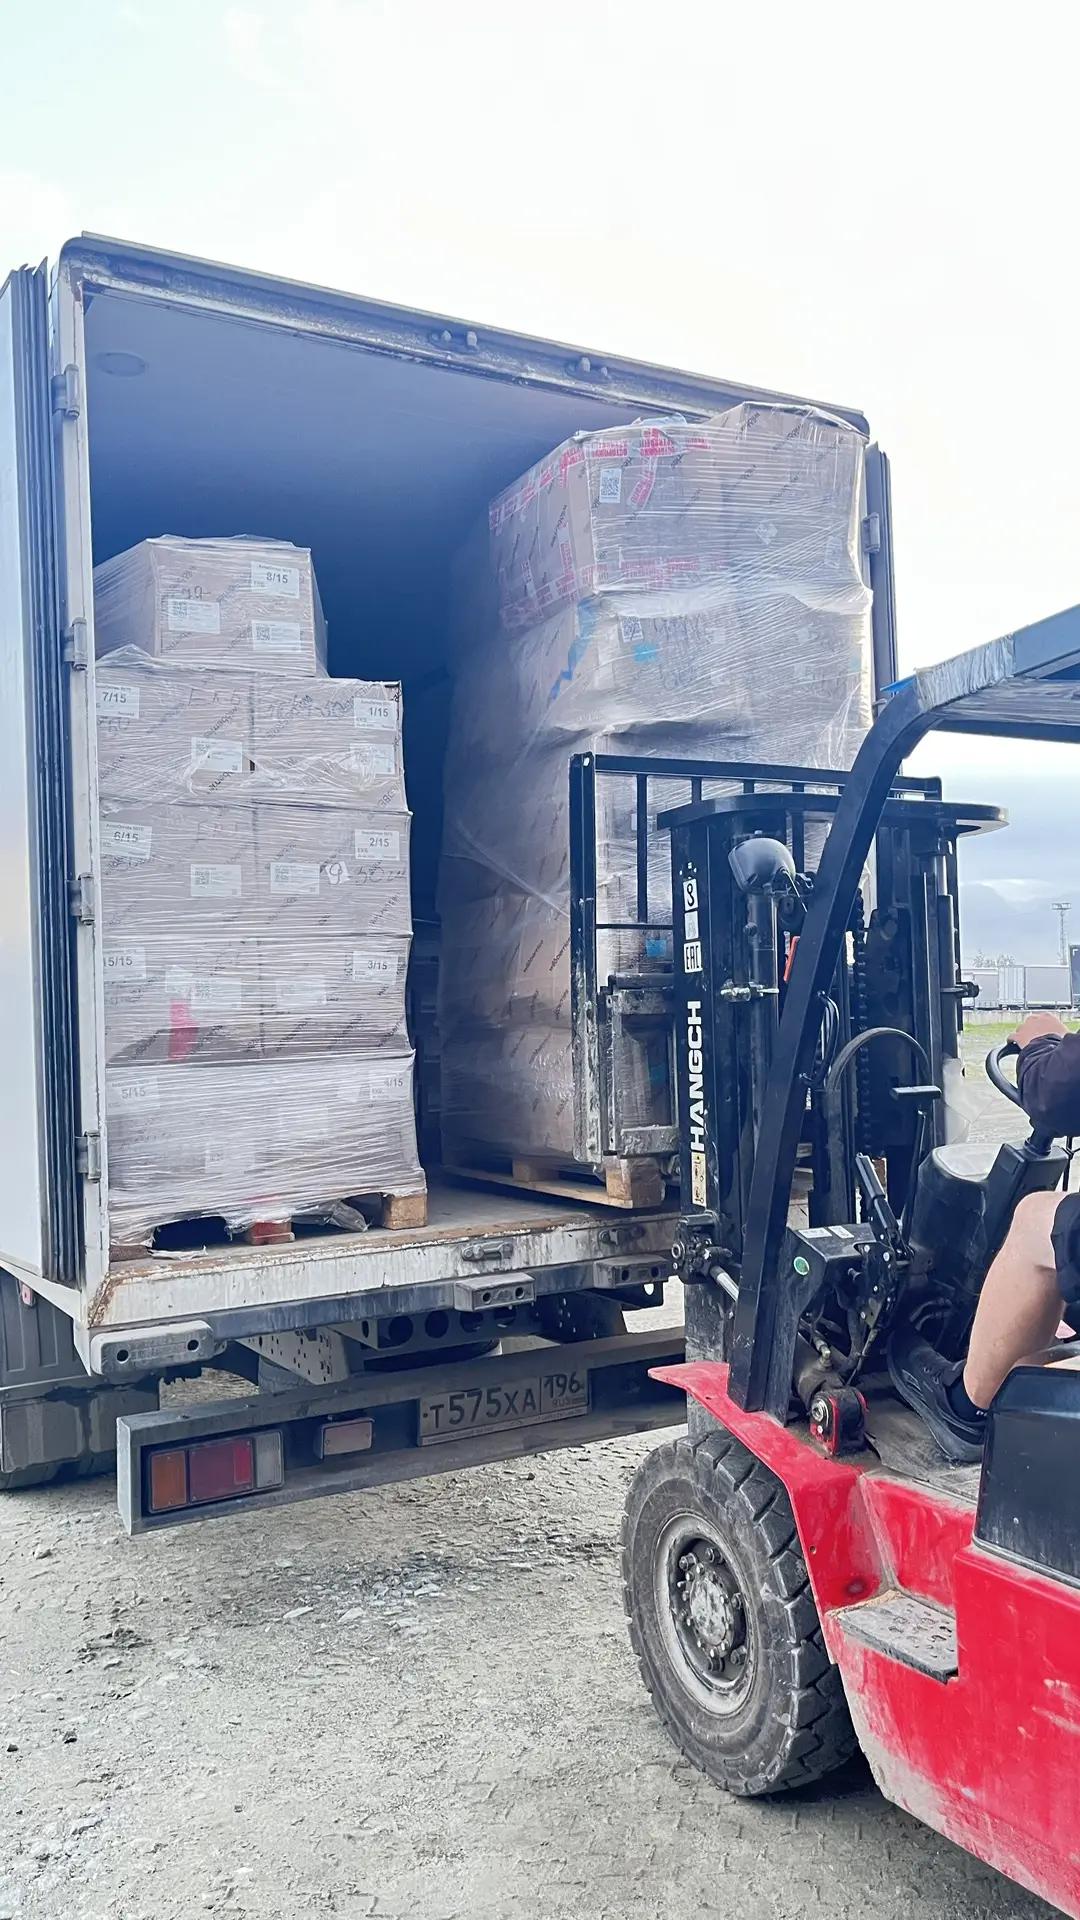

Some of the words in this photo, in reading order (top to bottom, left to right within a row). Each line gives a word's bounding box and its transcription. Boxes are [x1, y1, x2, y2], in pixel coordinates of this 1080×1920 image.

[265, 571, 288, 584] 8/15
[102, 692, 126, 704] 7/15
[369, 707, 388, 718] 1/15
[113, 831, 138, 843] 6/15
[369, 837, 389, 848] 2/15
[367, 959, 388, 970] 3/15
[687, 1000, 705, 1152] HANGCH
[121, 1087, 146, 1099] 5/15
[543, 1371, 582, 1398] 196
